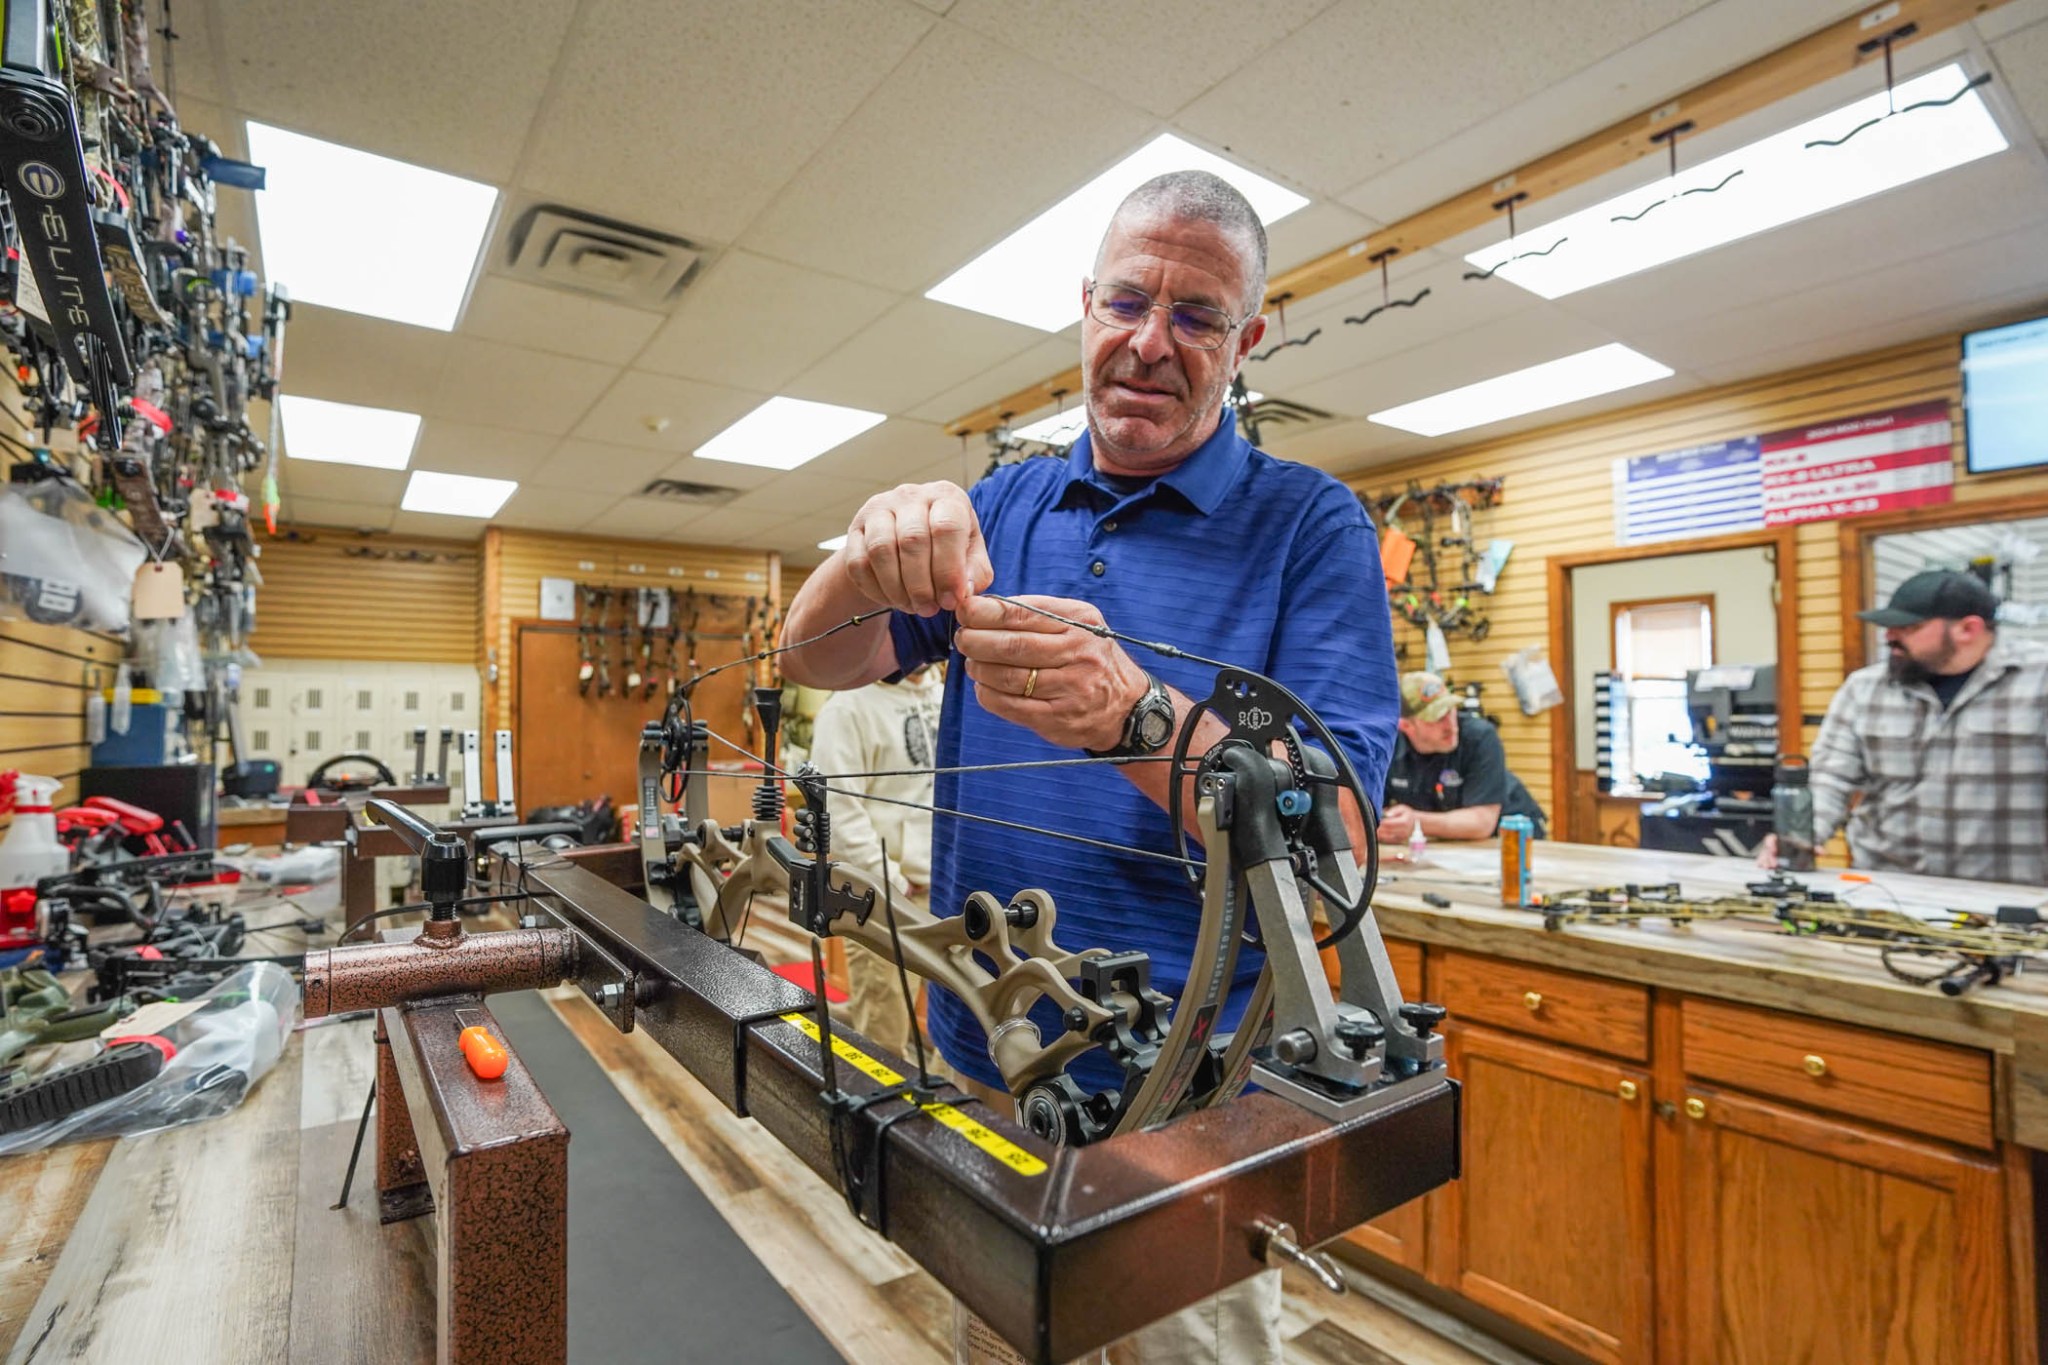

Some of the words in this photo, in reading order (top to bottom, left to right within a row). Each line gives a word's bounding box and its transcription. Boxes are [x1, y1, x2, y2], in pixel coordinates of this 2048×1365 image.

[41, 204, 90, 327] ELITE
[1238, 711, 1247, 726] CX
[1224, 880, 1235, 930] FOLLOW
[1220, 935, 1230, 950] TO
[1208, 956, 1226, 999] REFUSE
